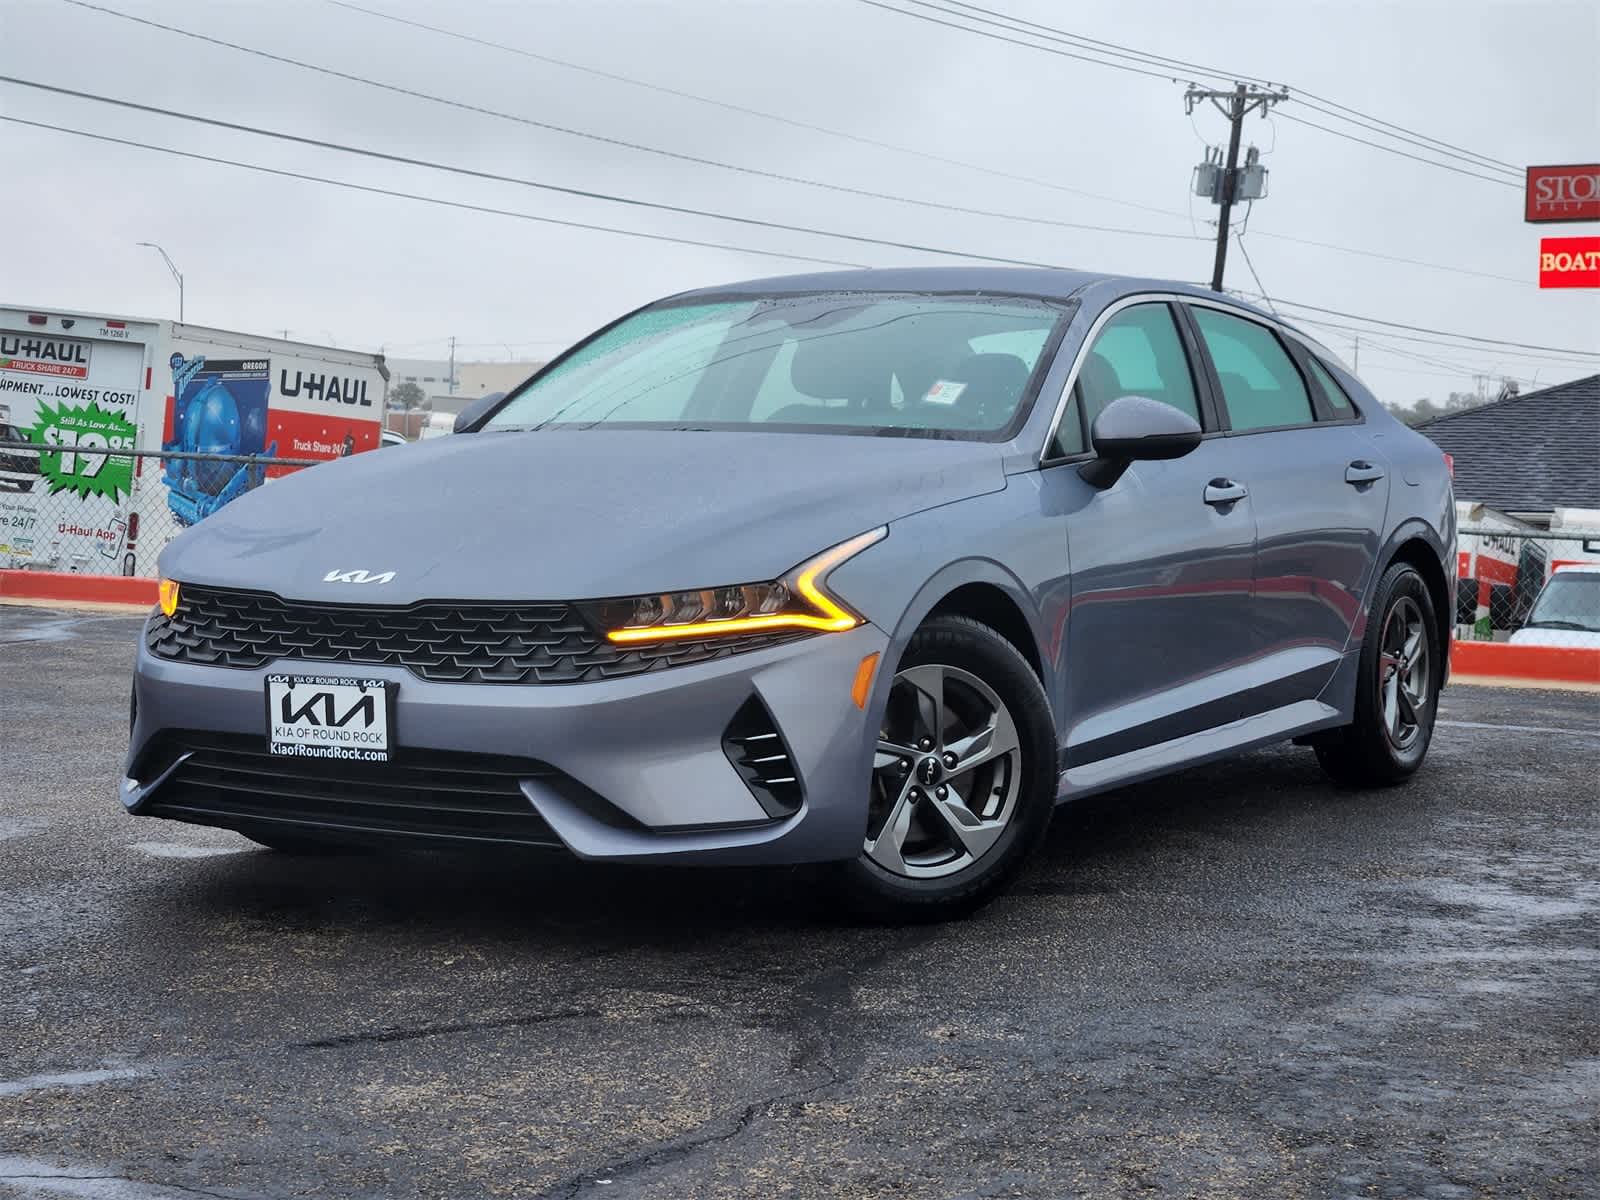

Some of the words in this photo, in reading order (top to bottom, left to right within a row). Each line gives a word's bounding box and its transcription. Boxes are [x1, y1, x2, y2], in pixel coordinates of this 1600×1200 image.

[12, 361, 38, 371] TRUCK
[38, 364, 62, 373] SHARE
[242, 361, 268, 370] OREGON
[281, 369, 372, 407] U-HAUL
[102, 391, 136, 405] COST!
[60, 416, 75, 426] Still
[76, 419, 87, 427] As
[89, 421, 106, 429] Low
[293, 439, 312, 451] Truck
[313, 442, 332, 453] Share
[332, 444, 347, 455] 24/7
[11, 516, 36, 529] 24/7
[58, 523, 93, 537] U-Haul
[96, 527, 116, 541] App
[323, 569, 397, 584] KIA
[316, 677, 339, 685] ROUND
[281, 691, 374, 729] KIA
[275, 727, 294, 738] KIA
[297, 728, 311, 738] OF
[313, 729, 350, 742] ROUND
[353, 732, 383, 744] ROCK
[270, 742, 388, 762] KiaofRoundRock.com
